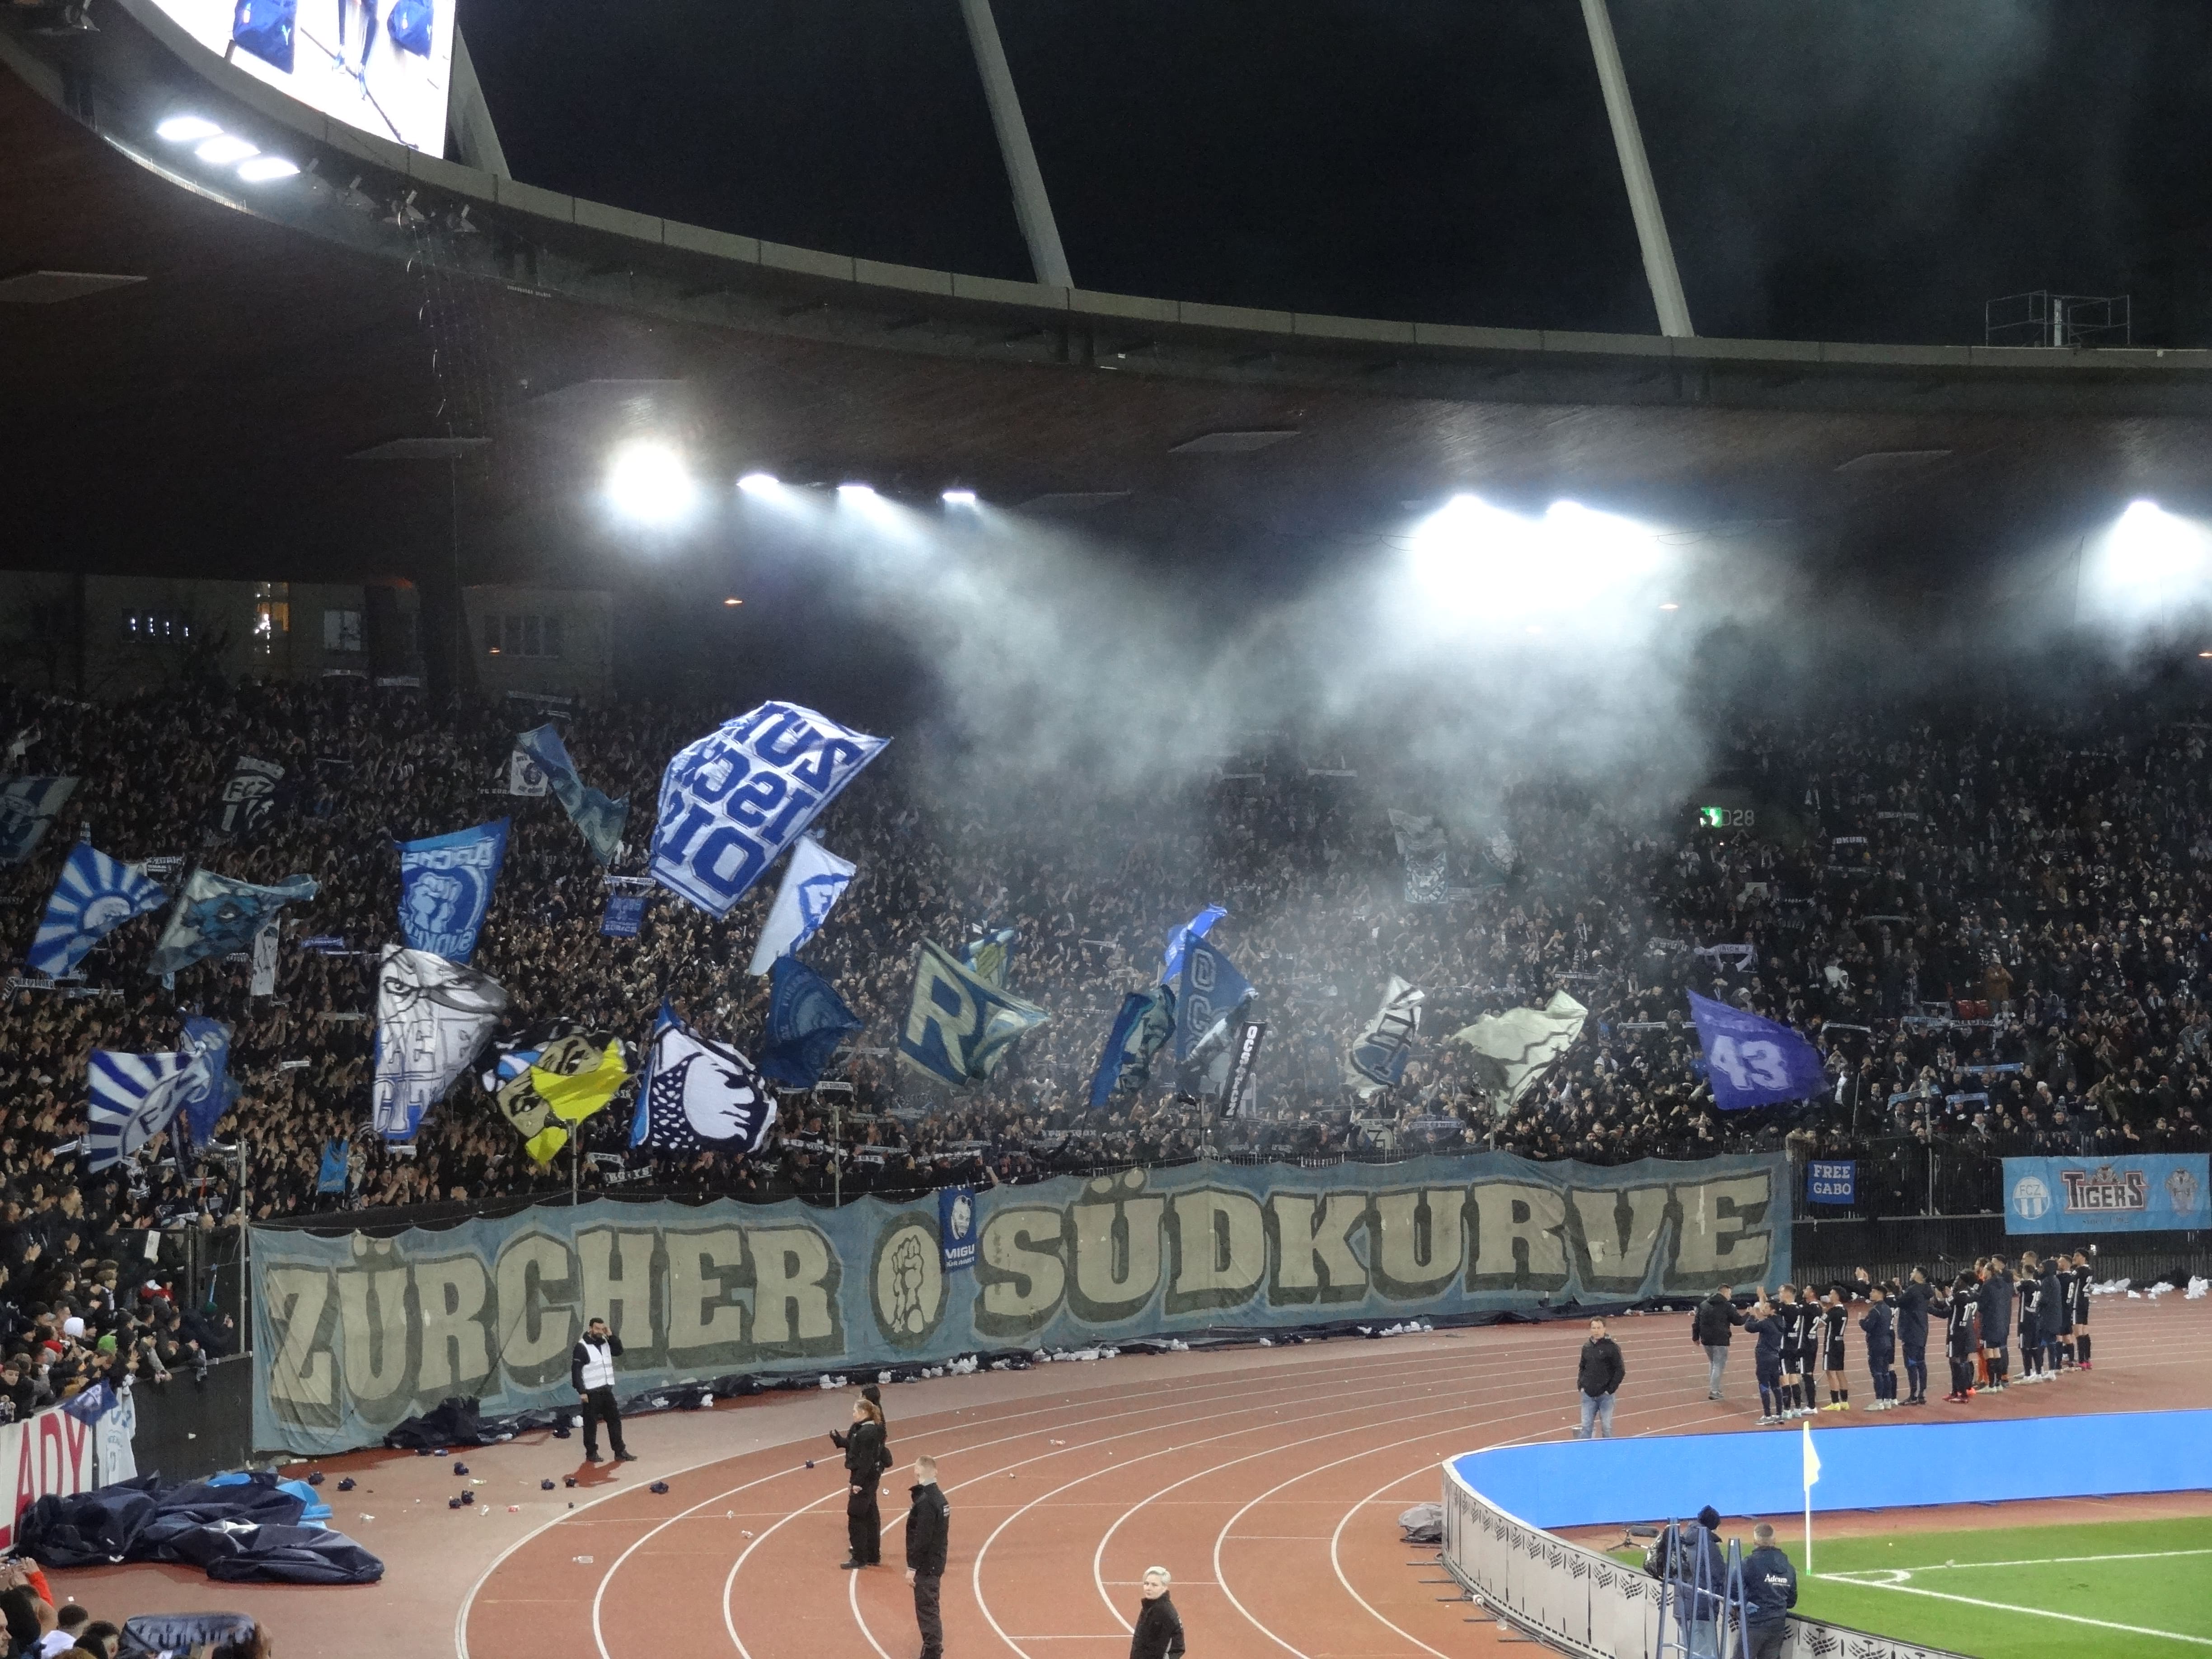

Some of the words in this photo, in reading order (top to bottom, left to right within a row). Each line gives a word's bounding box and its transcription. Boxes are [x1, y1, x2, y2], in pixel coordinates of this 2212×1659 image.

[1710, 1034, 1793, 1091] 43
[1813, 1164, 1850, 1179] FREE
[1813, 1181, 1852, 1196] GABO
[2020, 1184, 2042, 1196] FCZ
[2060, 1170, 2150, 1211] TIGERS
[945, 1243, 976, 1259] MIGU
[267, 1223, 844, 1423] ZÜRCHER
[976, 1168, 1771, 1333] SÜDKURVE
[0, 1411, 87, 1549] ADY
